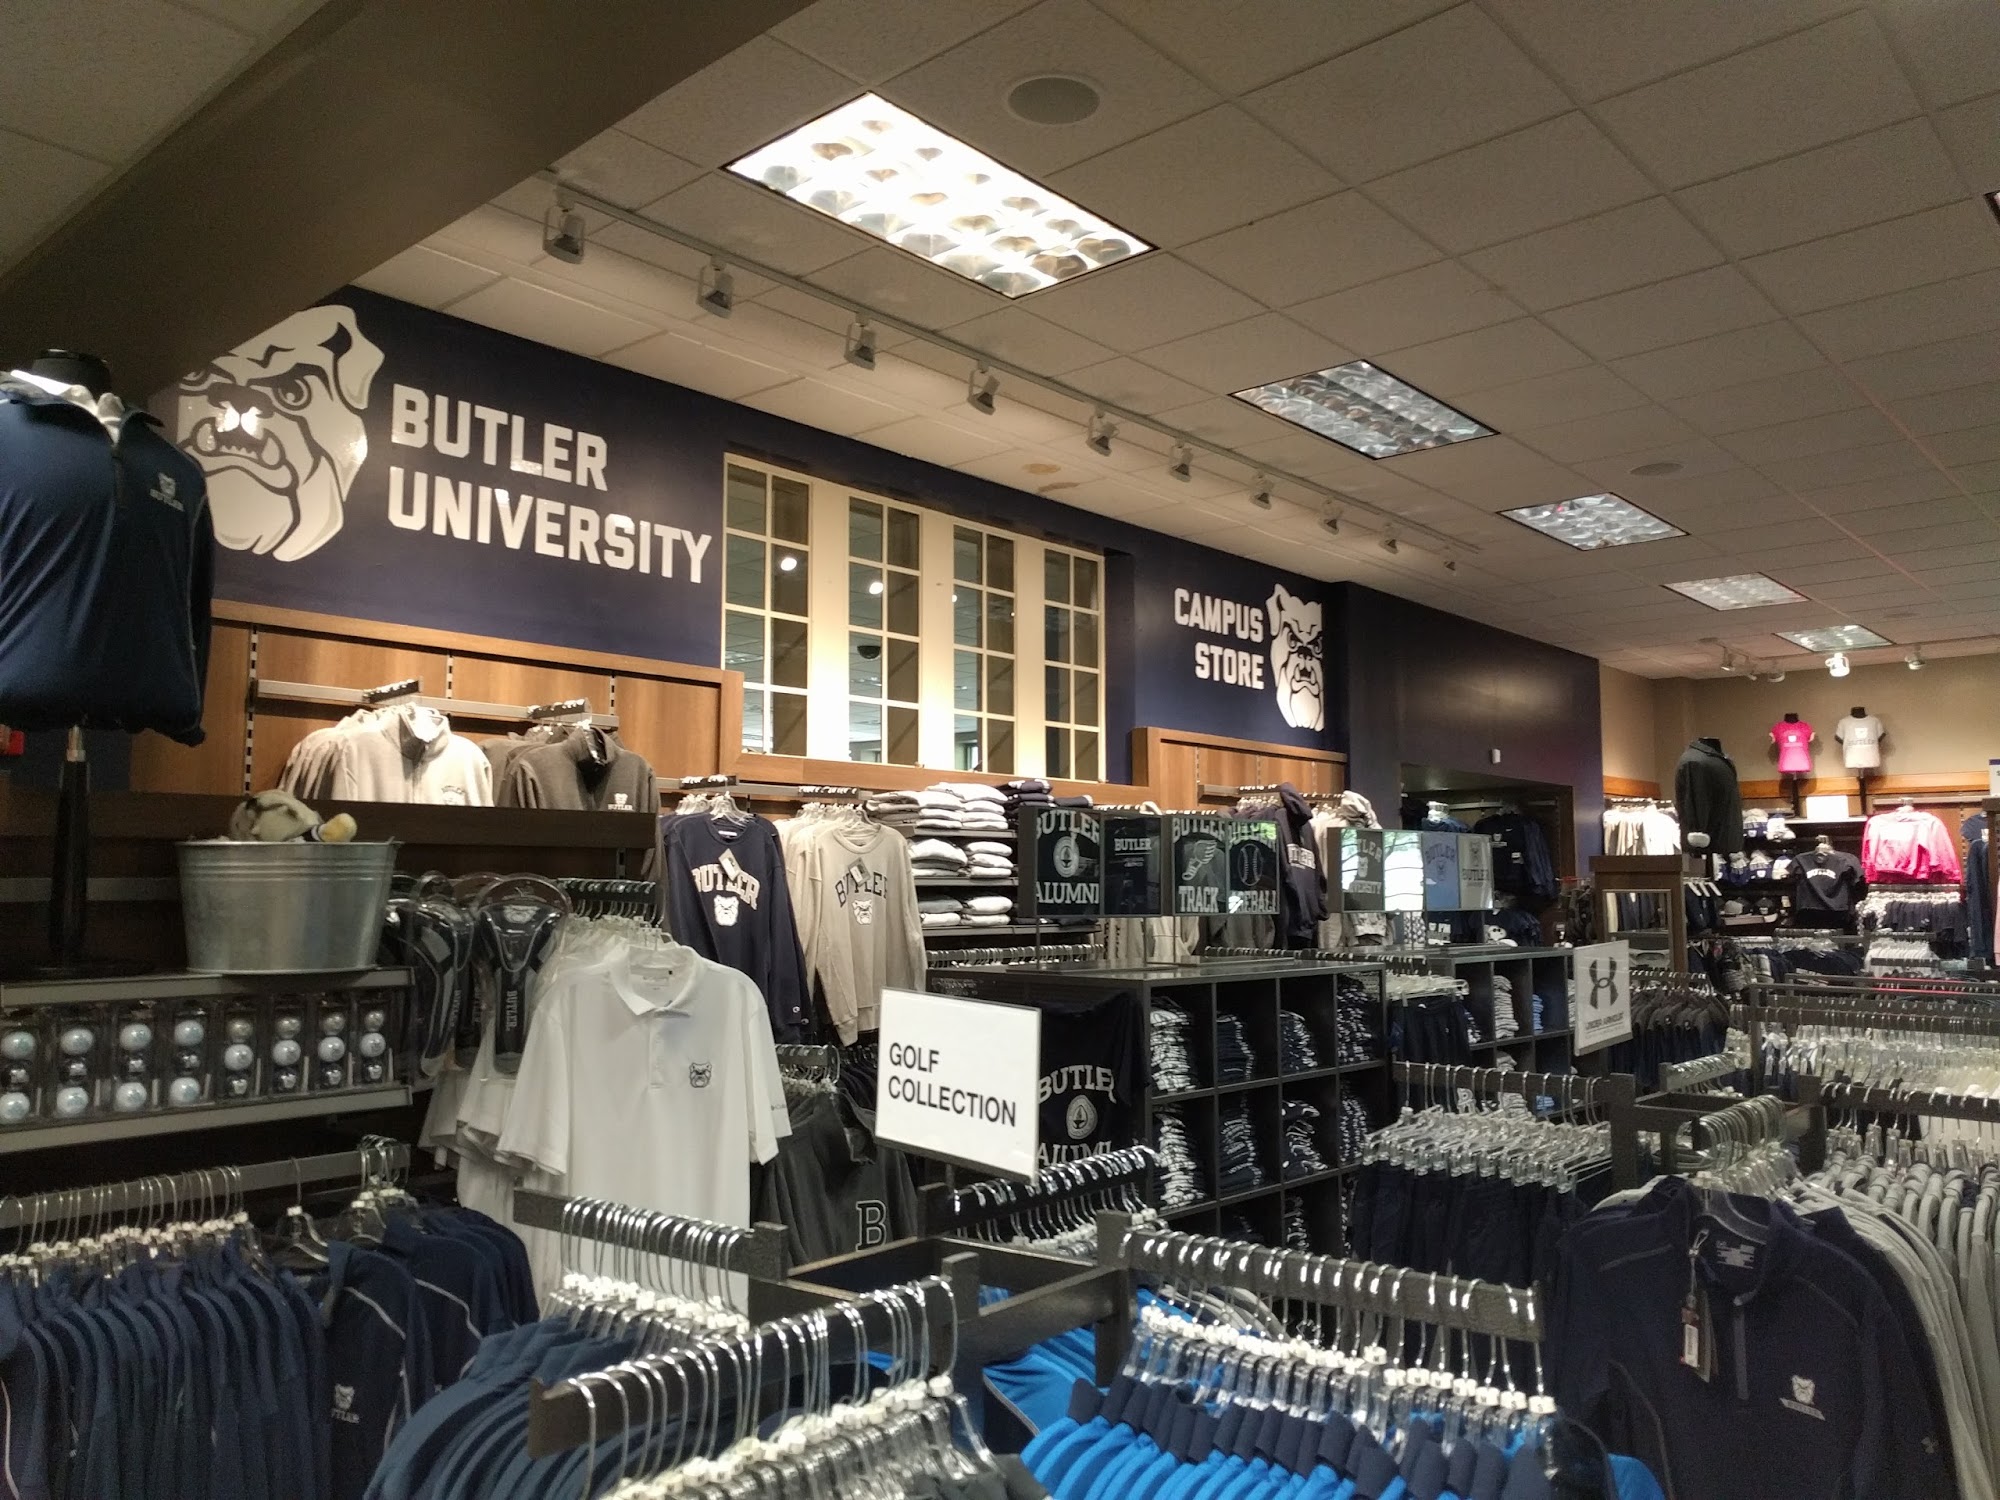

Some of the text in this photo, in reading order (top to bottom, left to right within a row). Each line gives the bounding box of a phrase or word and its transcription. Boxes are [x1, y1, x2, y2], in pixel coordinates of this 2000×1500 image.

[391, 383, 607, 492] BUTLER
[387, 466, 712, 584] UNIVERSITY
[1174, 588, 1264, 643] CAMPUS
[1195, 642, 1264, 689] STORE
[1114, 838, 1152, 851] BUTLER
[1178, 885, 1219, 913] TRACK
[889, 1042, 940, 1073] GOLF
[888, 1075, 1016, 1127] COLLECTION
[856, 1200, 887, 1251] B
